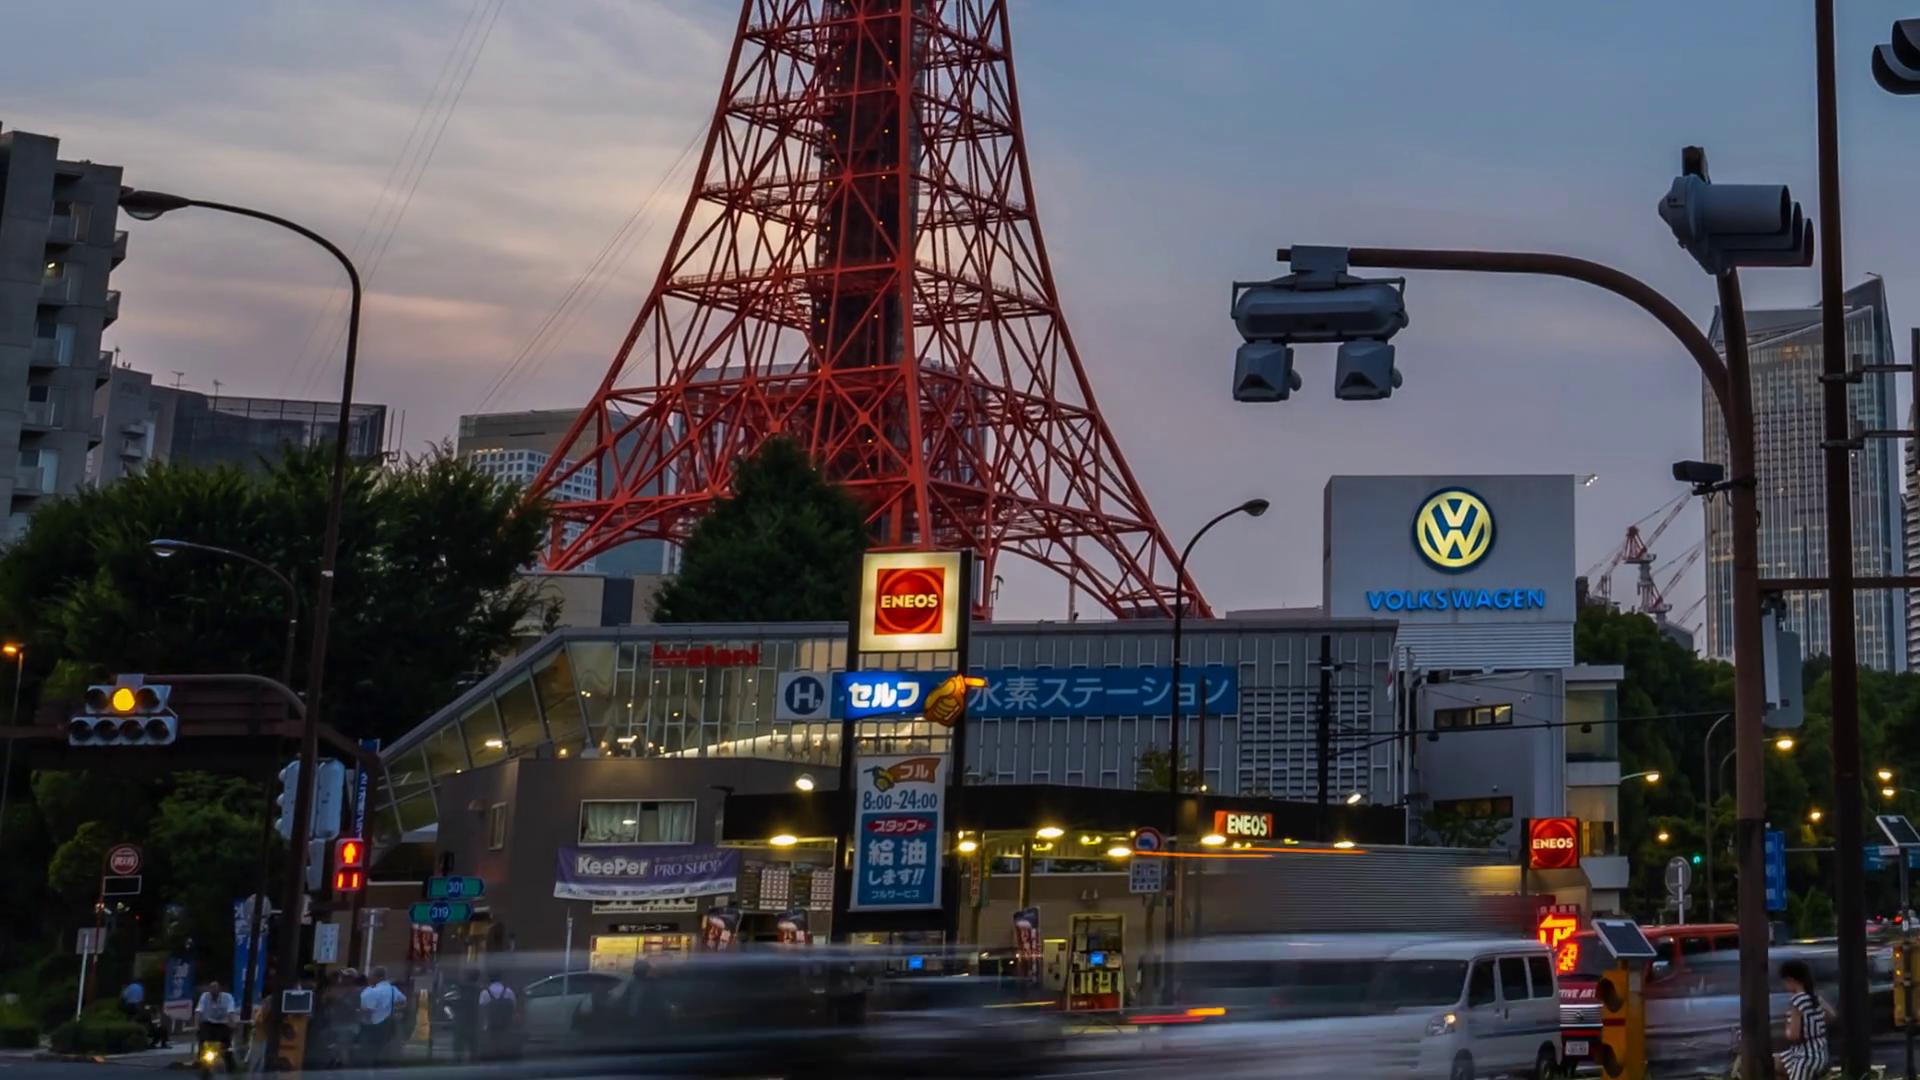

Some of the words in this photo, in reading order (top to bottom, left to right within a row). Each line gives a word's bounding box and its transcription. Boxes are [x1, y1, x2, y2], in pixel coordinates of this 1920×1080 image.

[880, 594, 938, 608] ENEOS
[1367, 588, 1545, 611] VOLKSWAGEN
[848, 681, 920, 709] セルフ
[968, 676, 1229, 712] 水素ステーション
[900, 764, 929, 779] フル
[873, 819, 926, 832] スタッフが
[1226, 813, 1268, 836] ENEOS
[1532, 837, 1574, 849] ENEOS
[868, 838, 928, 867] 給油
[577, 856, 649, 875] KeePer
[654, 863, 682, 877] PRO
[684, 859, 722, 875] SHOP
[447, 881, 464, 894] 301
[871, 890, 920, 899] フルサービス
[431, 906, 449, 919] 319
